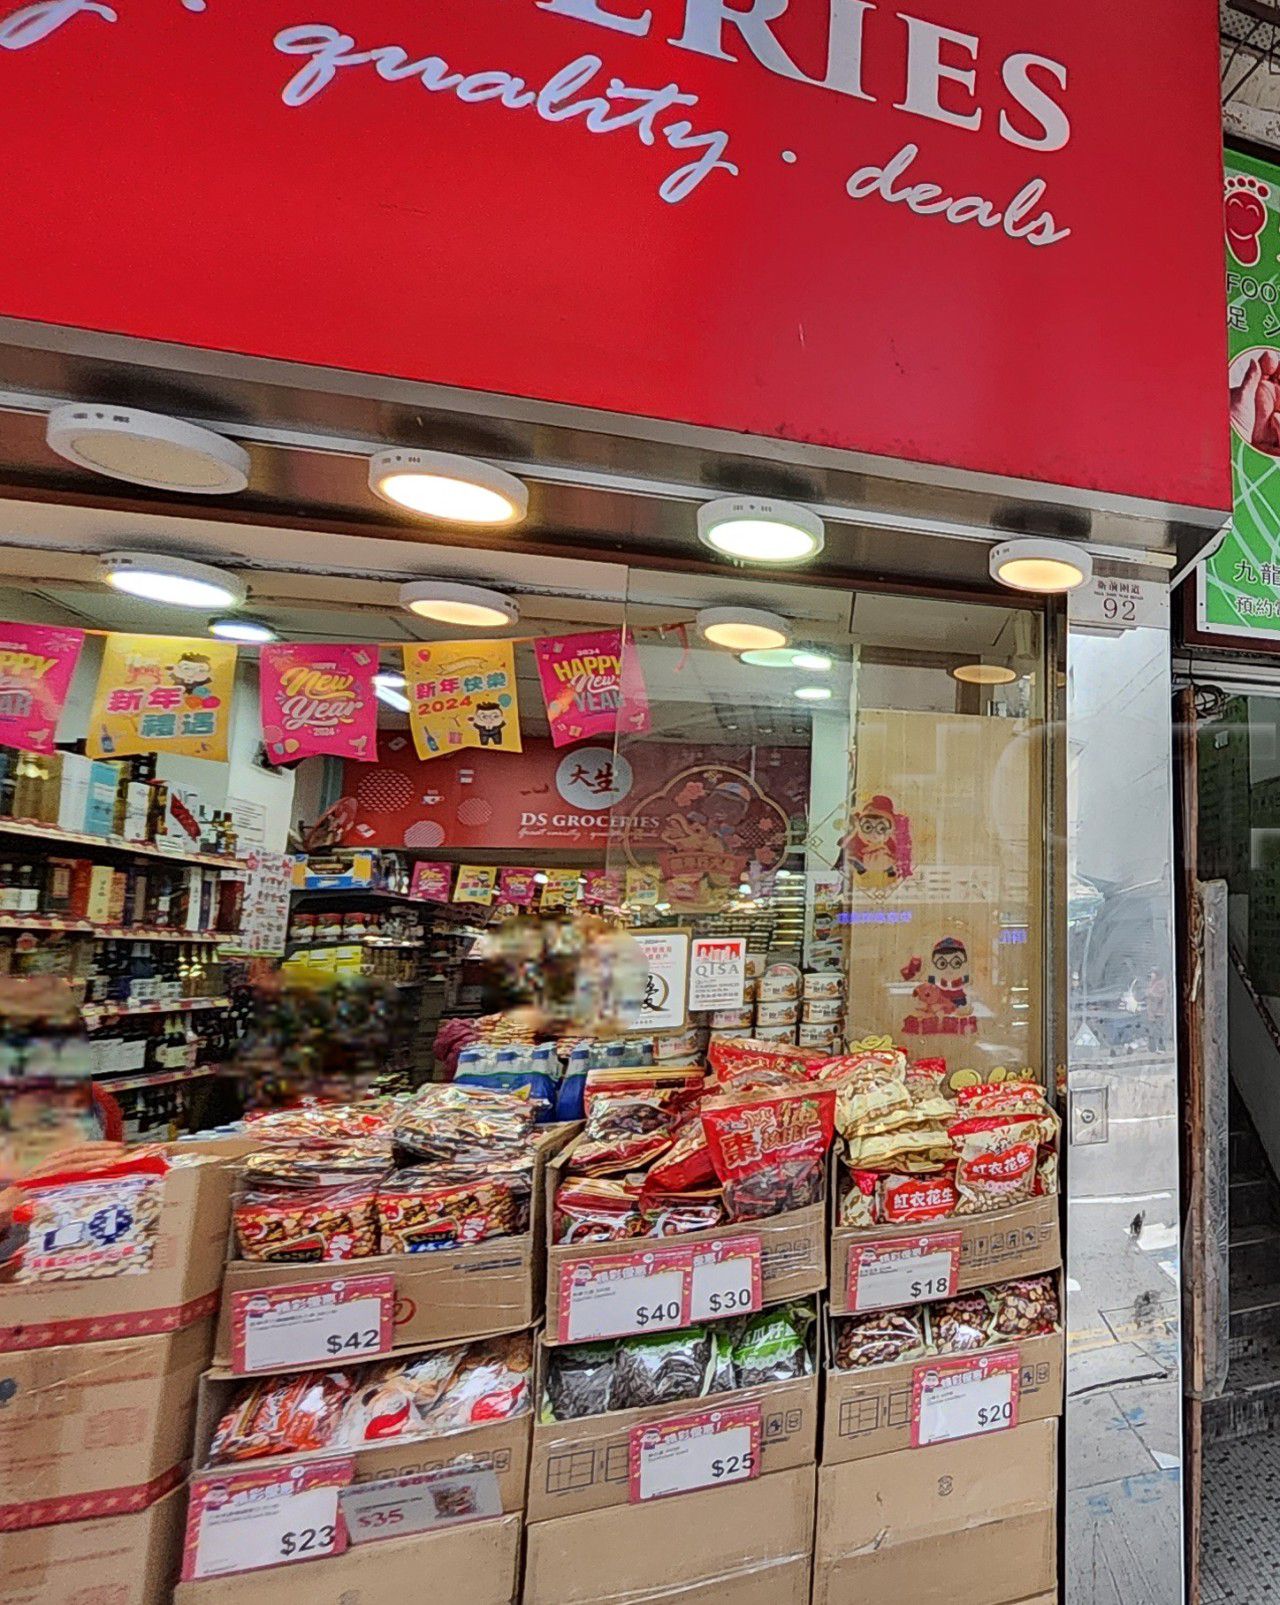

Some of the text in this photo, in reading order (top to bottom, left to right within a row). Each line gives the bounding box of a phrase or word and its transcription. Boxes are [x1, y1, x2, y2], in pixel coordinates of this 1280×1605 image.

[273, 23, 739, 204] quality
[846, 143, 1072, 246] deals
[1103, 597, 1137, 621] 92
[279, 666, 356, 700] New
[281, 695, 364, 731] Year
[418, 694, 473, 716] 2024
[567, 762, 620, 795] 大生
[520, 812, 548, 827] DS
[708, 1287, 752, 1313] $30
[909, 1276, 948, 1299] $18
[635, 1300, 681, 1326] $40
[326, 1328, 381, 1355] $42
[976, 1401, 1014, 1427] $20
[711, 1451, 756, 1479] $25
[356, 1507, 405, 1528] $35
[280, 1524, 336, 1557] $23
